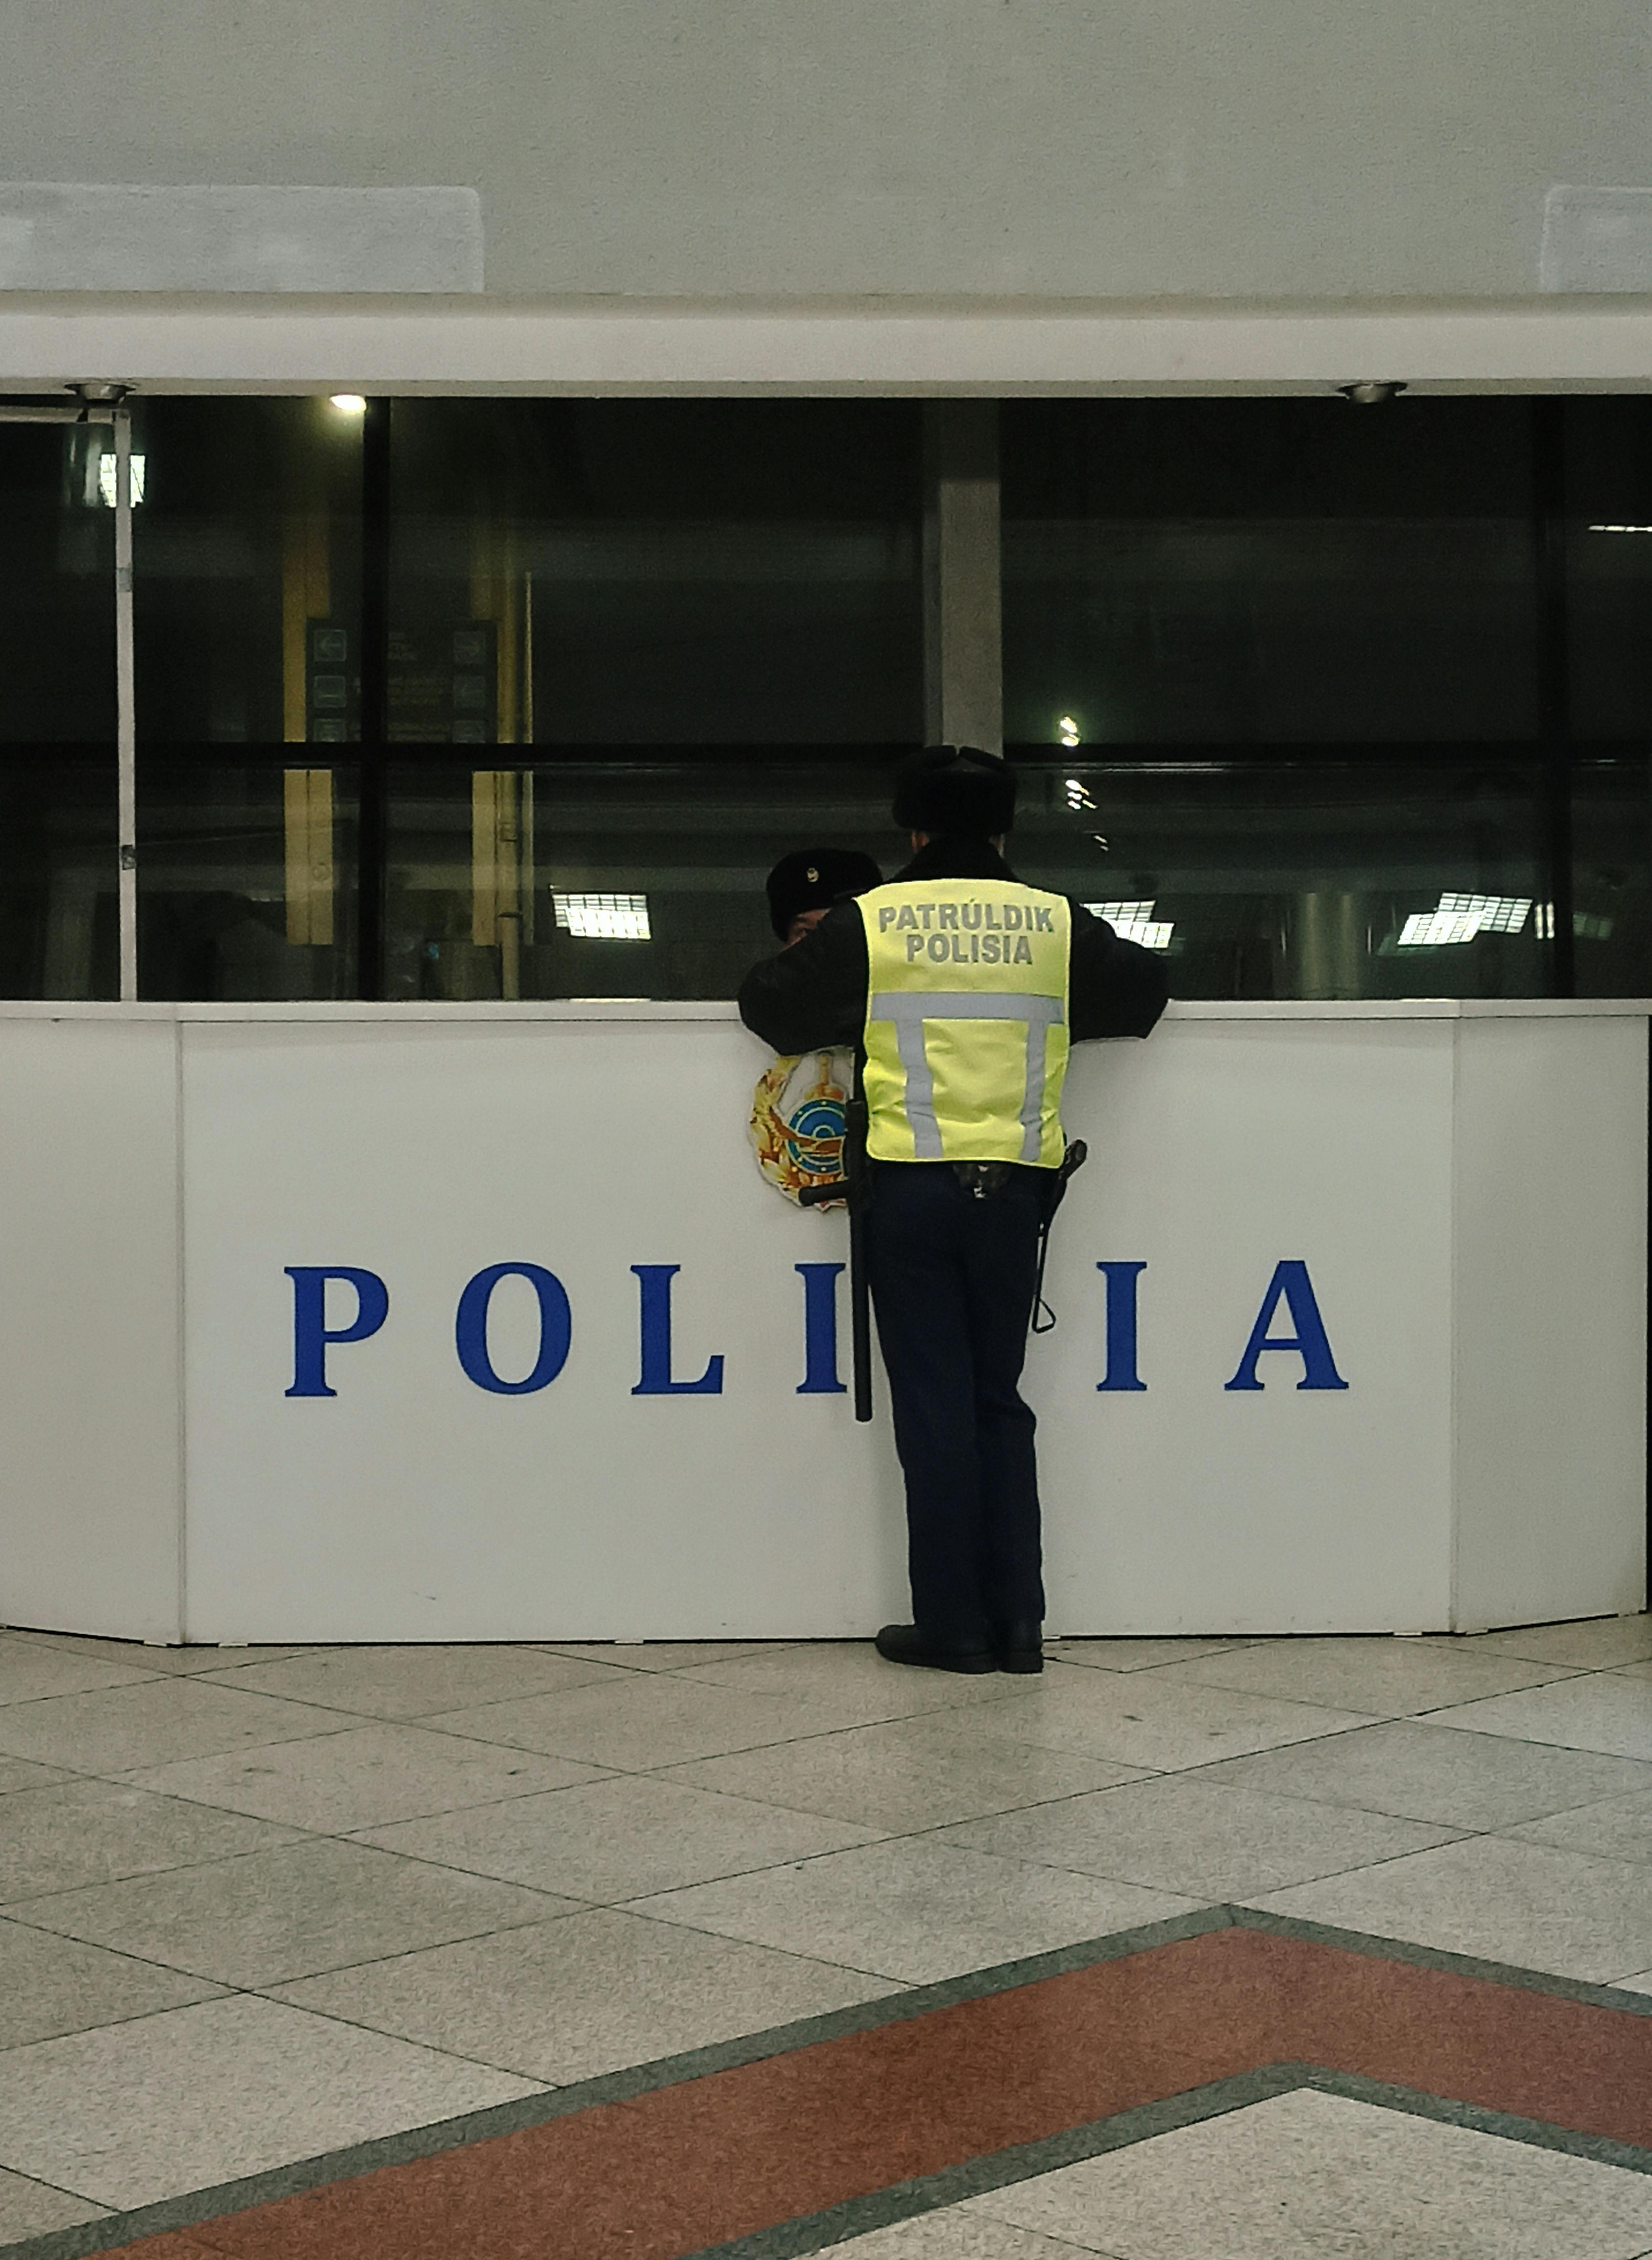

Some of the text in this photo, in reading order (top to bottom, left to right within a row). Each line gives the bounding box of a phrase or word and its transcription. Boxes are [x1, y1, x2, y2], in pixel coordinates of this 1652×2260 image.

[880, 899, 1053, 933] PATRÚLDIK
[906, 934, 1032, 964] POLISIA
[284, 1260, 1349, 1397] POLIIA
